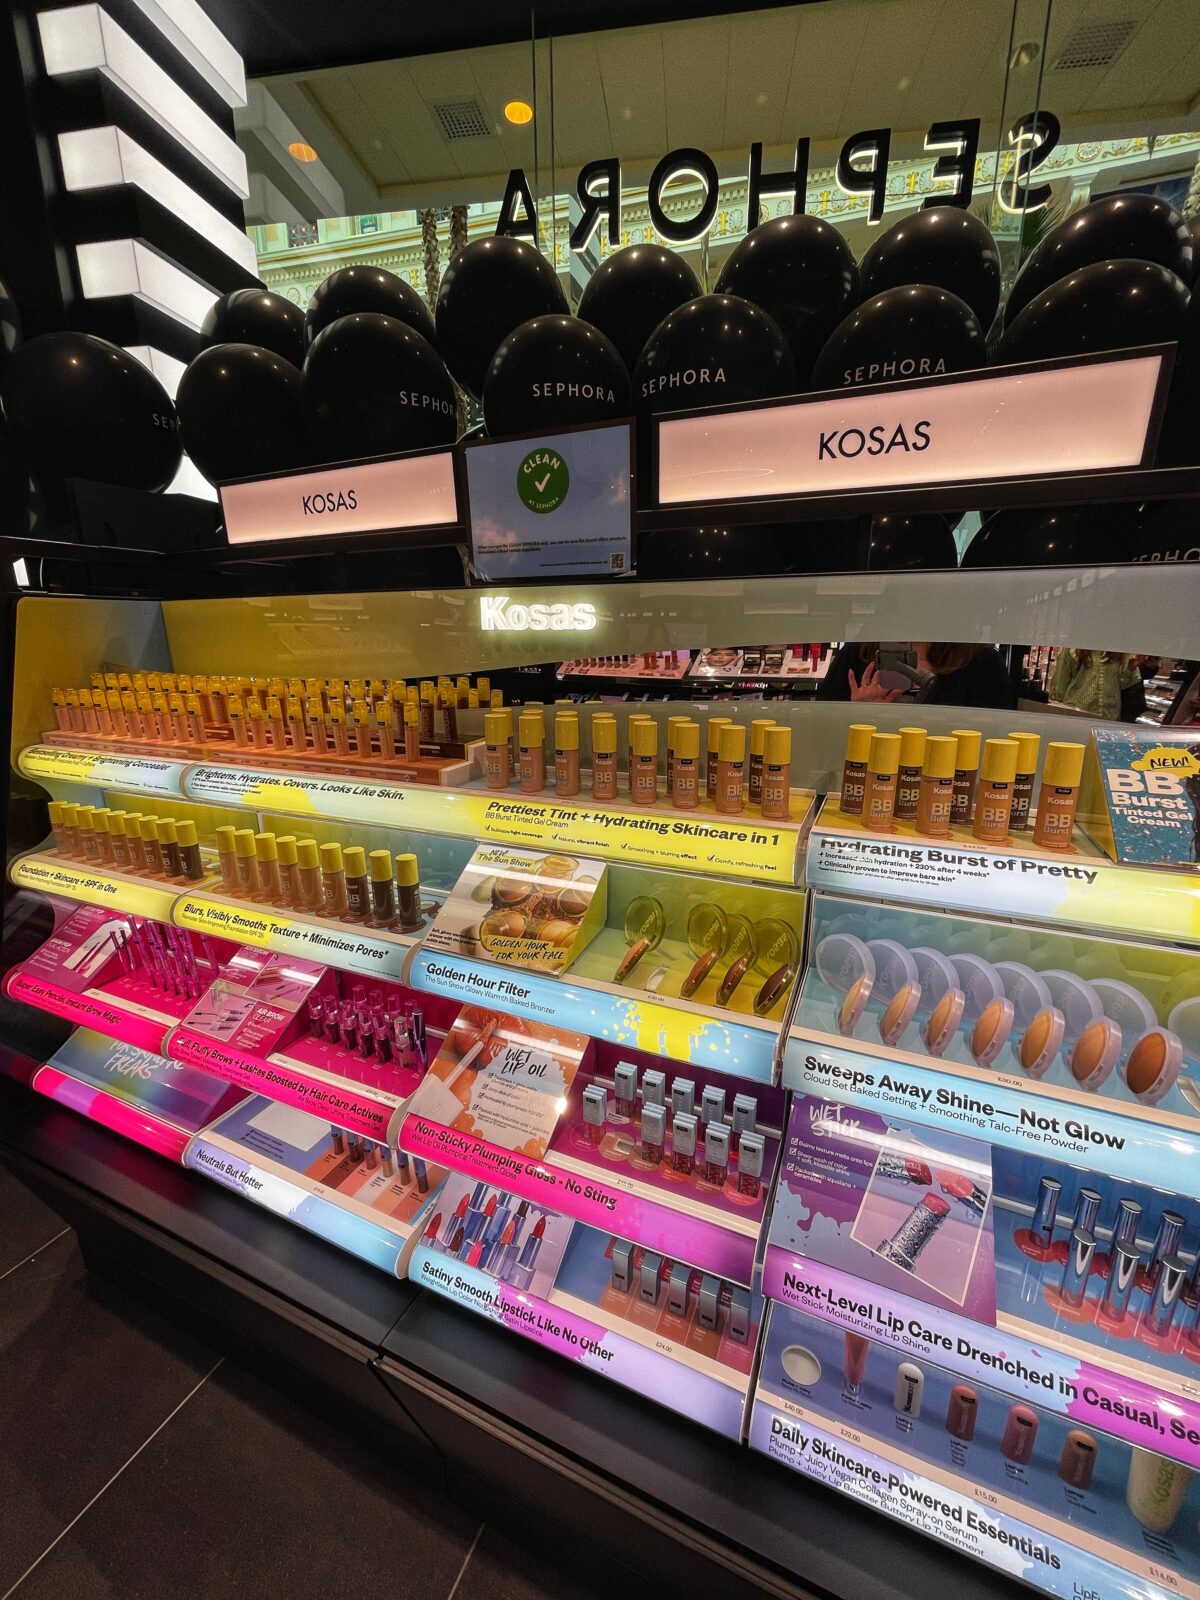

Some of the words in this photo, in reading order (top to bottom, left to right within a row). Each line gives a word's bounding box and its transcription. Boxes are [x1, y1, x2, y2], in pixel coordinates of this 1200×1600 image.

[844, 358, 947, 385] SEPHORA
[641, 368, 726, 397] SEPHORA
[533, 383, 614, 403] SEPHORA
[400, 391, 457, 416] SEPHOR
[818, 420, 931, 460] KOSAS
[524, 454, 560, 473] CLEAN
[302, 490, 357, 515] KOSAS
[480, 597, 597, 630] Kosas
[93, 756, 132, 767] Brightening
[132, 760, 171, 771] Concealer
[1150, 756, 1189, 769] NEW!
[595, 772, 613, 782] BB
[637, 777, 654, 787] BB
[846, 770, 865, 778] Kosas
[1107, 768, 1184, 795] BB
[195, 769, 236, 780] Brightens.
[238, 774, 281, 785] Hydrates.
[283, 779, 318, 790] Covers.
[320, 783, 352, 794] Looks
[352, 786, 376, 796] Like
[377, 789, 404, 800] Skin.
[677, 778, 695, 789] BB
[844, 783, 864, 796] BB
[765, 788, 784, 800] BB
[984, 792, 1008, 800] Kosas
[1048, 796, 1073, 805] Kosas
[1112, 792, 1188, 809] Burst
[871, 798, 892, 812] BB
[983, 807, 1006, 821] BB
[1112, 807, 1163, 818] Tinted
[1165, 811, 1193, 820] Gel
[487, 801, 547, 816] Prettiest
[549, 808, 580, 821] Tint
[593, 813, 670, 834] Hydrating
[672, 822, 747, 842] Skincare
[750, 832, 767, 844] in
[772, 835, 780, 846] 1
[513, 815, 533, 823] Tinted
[546, 820, 568, 828] Cream
[1045, 813, 1071, 827] BB
[1127, 816, 1181, 827] Cream
[478, 854, 492, 862] The
[493, 856, 509, 865] Sun
[510, 859, 532, 868] Show
[821, 838, 924, 863] Hydrating
[928, 849, 989, 868] Burst
[993, 859, 1016, 871] of
[1021, 860, 1098, 884] Pretty
[874, 858, 907, 868] hydration
[915, 864, 936, 872] 230%
[937, 866, 955, 874] after
[19, 864, 50, 877] Foundation
[54, 872, 80, 884] Skincare
[104, 884, 117, 894] One
[824, 861, 854, 870] Clinically
[855, 866, 879, 874] proven
[889, 869, 918, 878] improve
[919, 872, 936, 880] bare
[184, 903, 204, 917] Blurs,
[206, 908, 232, 924] Visibly
[232, 915, 268, 931] Smooths
[269, 923, 301, 939] Texture
[309, 933, 355, 952] Minimizes
[490, 938, 521, 948] GOLDEN
[524, 941, 548, 950] HOUR
[495, 952, 514, 960] FOR
[517, 951, 539, 960] YOUR
[541, 951, 563, 960] FACE
[426, 963, 466, 983] Golden
[467, 973, 496, 990] Hour
[498, 981, 531, 998] Filter
[425, 975, 436, 983] The
[436, 977, 448, 986] Sun
[448, 981, 465, 991] Show
[465, 985, 484, 996] Glowy
[485, 991, 509, 1002] Warmth
[509, 996, 530, 1008] Baked
[531, 1002, 556, 1015] Bronzer
[505, 1048, 535, 1063] WET
[104, 1052, 158, 1079] FREAKS
[501, 1061, 524, 1075] LIP
[528, 1064, 547, 1077] OIL
[192, 1042, 211, 1057] Fluffy
[211, 1049, 233, 1065] Brows
[240, 1061, 265, 1077] Lashes
[265, 1071, 300, 1090] Boosted
[299, 1083, 309, 1096] by
[309, 1087, 328, 1101] Hair
[328, 1095, 349, 1110] Care
[349, 1103, 384, 1123] Actives
[804, 1056, 874, 1086] Sweeps
[878, 1074, 932, 1103] Away
[1065, 1120, 1126, 1150] Glow
[803, 1072, 830, 1086] Cloud
[832, 1079, 847, 1090] Set
[850, 1085, 880, 1098] Baked
[881, 1091, 917, 1110] Setting
[928, 1104, 986, 1128] Smoothing
[988, 1118, 1041, 1141] Talc-Free
[1043, 1133, 1089, 1153] Powder
[809, 1104, 845, 1121] WET
[196, 1149, 225, 1171] Neutrals
[225, 1164, 240, 1178] But
[240, 1171, 263, 1190] Hotter
[415, 1121, 471, 1153] Non-Sticky
[472, 1143, 523, 1173] Plumping
[525, 1164, 557, 1185] Gloss
[565, 1178, 582, 1194] No
[584, 1186, 618, 1211] Sting
[468, 1155, 499, 1173] Treatment
[423, 1261, 454, 1286] Satiny
[454, 1276, 492, 1304] Smooth
[494, 1295, 536, 1325] Lipstick
[537, 1315, 560, 1336] Like
[562, 1327, 577, 1345] No
[580, 1337, 614, 1361] Other
[782, 1288, 799, 1302] Wet
[801, 1295, 824, 1312] Stick
[826, 1307, 883, 1336] Moisturizing
[884, 1329, 900, 1342] Lip
[902, 1336, 931, 1354] Shine
[520, 1323, 543, 1338] Lipstick
[783, 1272, 873, 1319] Next-Level
[876, 1307, 904, 1332] Lip
[908, 1320, 953, 1350] Care
[957, 1338, 1053, 1389] Drenched
[1059, 1377, 1077, 1399] in
[1083, 1387, 1166, 1434] Casual,
[784, 1402, 803, 1415] £40.00
[841, 1428, 861, 1443] £22.00
[769, 1435, 796, 1455] Plump
[805, 1454, 828, 1472] Juicy
[829, 1462, 857, 1484] Vegan
[858, 1477, 899, 1504] Collagen
[899, 1499, 944, 1527] Spray-on
[945, 1520, 978, 1544] Serum
[772, 1418, 809, 1451] Daily
[812, 1437, 962, 1523] Skincare-Powered
[966, 1509, 1061, 1570] Essentials
[974, 1488, 997, 1504] £15.00
[769, 1445, 795, 1463] Plump
[804, 1465, 827, 1482] Juicy
[827, 1471, 843, 1487] Lip
[843, 1481, 878, 1505] Booster
[880, 1501, 915, 1523] Buttery
[916, 1518, 932, 1531] Lip
[935, 1527, 984, 1556] Treatment
